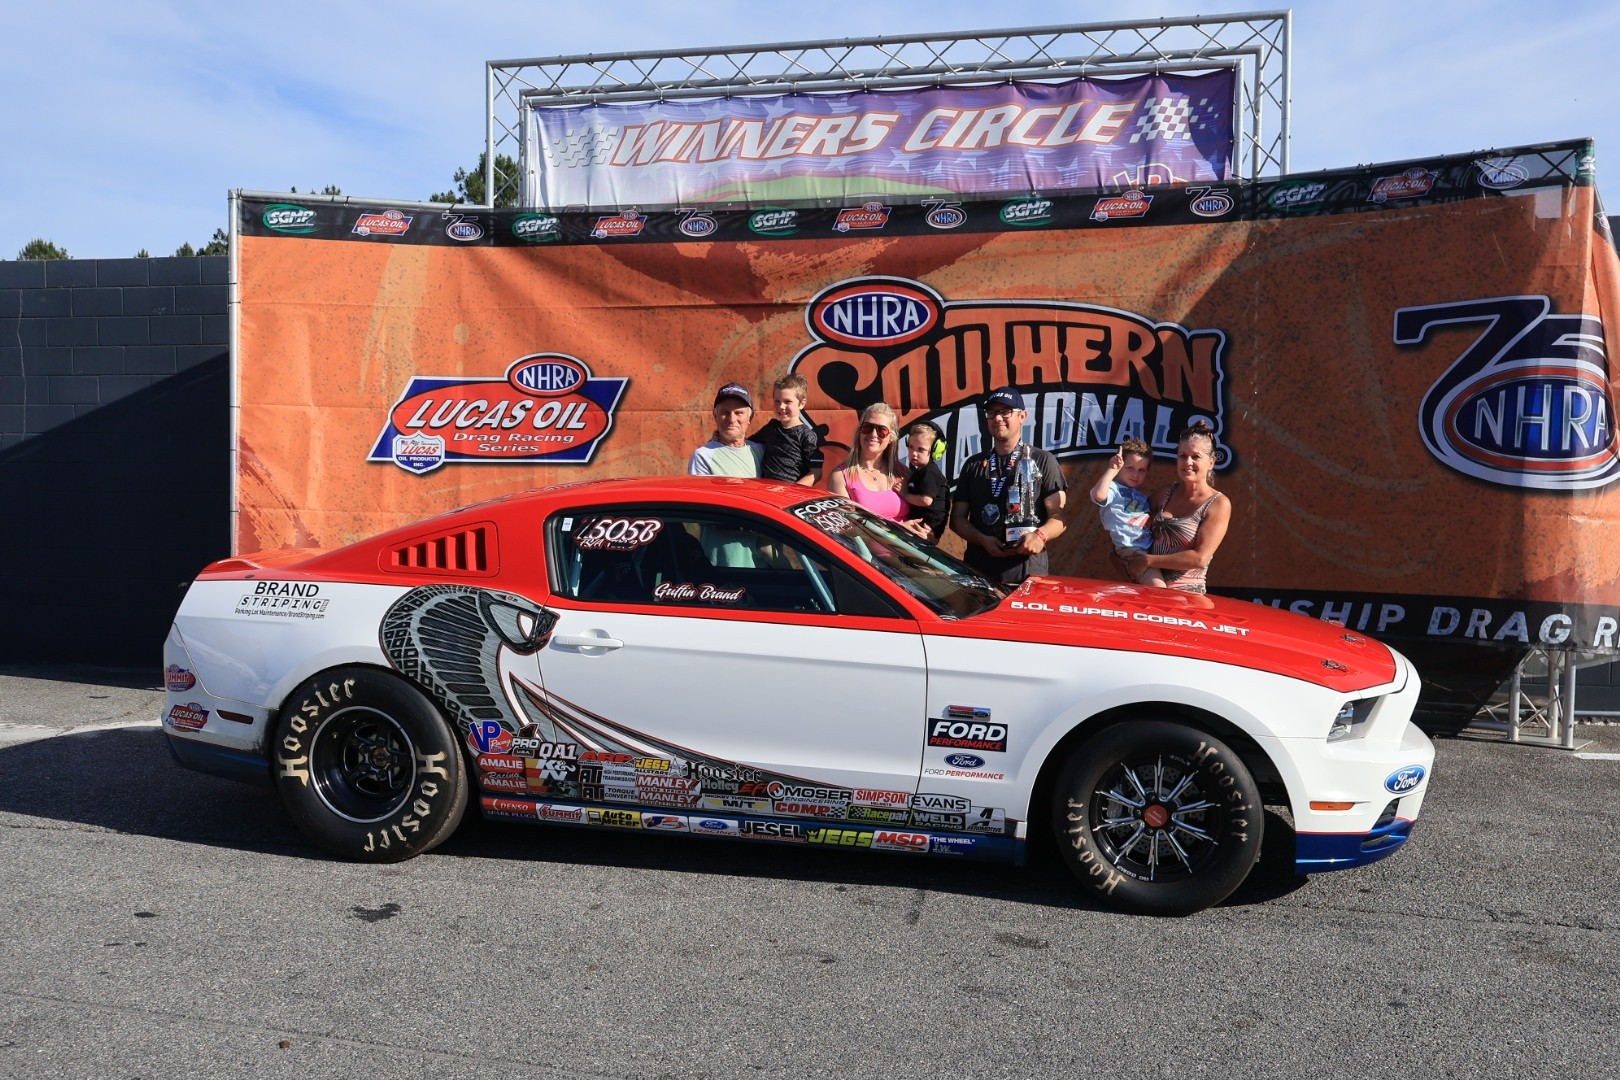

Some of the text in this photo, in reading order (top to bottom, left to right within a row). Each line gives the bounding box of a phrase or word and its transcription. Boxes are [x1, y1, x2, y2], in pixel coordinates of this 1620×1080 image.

[609, 100, 1136, 167] WINNERS CIRCLE
[1377, 180, 1409, 192] LUCAS
[1411, 178, 1427, 188] OIL
[1275, 183, 1327, 205] SGMP
[1004, 200, 1050, 219] SGMP
[1099, 202, 1143, 211] LUCAS OIL
[1198, 200, 1224, 212] NHRA
[268, 209, 315, 224] SGMP
[754, 210, 797, 228] SGMP
[841, 213, 882, 222] LUCAS OIL
[933, 212, 957, 224] NHRA
[361, 219, 404, 229] LUCAS OIL
[454, 225, 477, 237] NHRA
[516, 218, 559, 234] SGMP
[600, 221, 639, 229] LUCAS OIL
[687, 220, 709, 233] NHRA
[833, 298, 921, 336] NHRA
[522, 364, 575, 390] NHRA
[793, 307, 1217, 490] SOUTHERN
[405, 399, 588, 430] LUCAS OIL
[1474, 383, 1610, 450] NHRA
[453, 432, 501, 444] Drag
[507, 432, 575, 444] Racing
[401, 446, 439, 455] LUCAS
[477, 443, 539, 453] Series
[794, 500, 839, 519] FORD
[254, 581, 320, 598] BRAND
[654, 583, 744, 600] Griffin Brand
[241, 596, 322, 610] STRIPING
[234, 608, 252, 617] Parking
[1059, 605, 1128, 619] SUPER
[1133, 612, 1208, 630] COBRA
[1212, 624, 1250, 637] JET
[1426, 605, 1573, 645] DRAG
[171, 708, 204, 722] LUCAS OIL
[278, 678, 355, 787] Hoosier
[469, 720, 502, 753] VP
[932, 721, 1006, 741] FORD
[512, 737, 540, 749] PRO
[929, 737, 1003, 750] PERFORMANCE
[539, 742, 577, 760] QA1
[579, 752, 634, 764] ARP
[480, 758, 523, 769] AMALIE
[635, 758, 670, 771] JEGS
[952, 755, 977, 767] Ford
[487, 771, 520, 780] Racing
[683, 760, 762, 783] Hoosier
[925, 768, 1004, 780] FORD PERFORMANCE
[483, 778, 527, 789] AMALIE
[638, 776, 693, 789] MANLEY
[702, 779, 739, 794] Holley
[1393, 768, 1419, 791] Ford
[608, 787, 636, 795] TORQUE
[640, 791, 695, 804] MANLEY
[784, 785, 852, 801] MOSER
[856, 790, 907, 804] SIMPSON
[364, 747, 449, 852] Hoosier
[500, 802, 529, 811] DENSO
[722, 799, 756, 809] M/T
[783, 796, 847, 806] ENGINEERING
[912, 796, 967, 810] EVANS
[602, 810, 632, 821] Auto
[775, 803, 831, 815] COMP
[863, 807, 909, 822] Racepak
[601, 818, 640, 828] Meter
[703, 821, 724, 829] Ford
[913, 812, 963, 825] WELD
[914, 821, 963, 830] RACING
[740, 820, 807, 840] JESEL
[807, 828, 874, 848] JEGS
[876, 831, 928, 847] MSD
[1063, 798, 1127, 895] Hoosier
